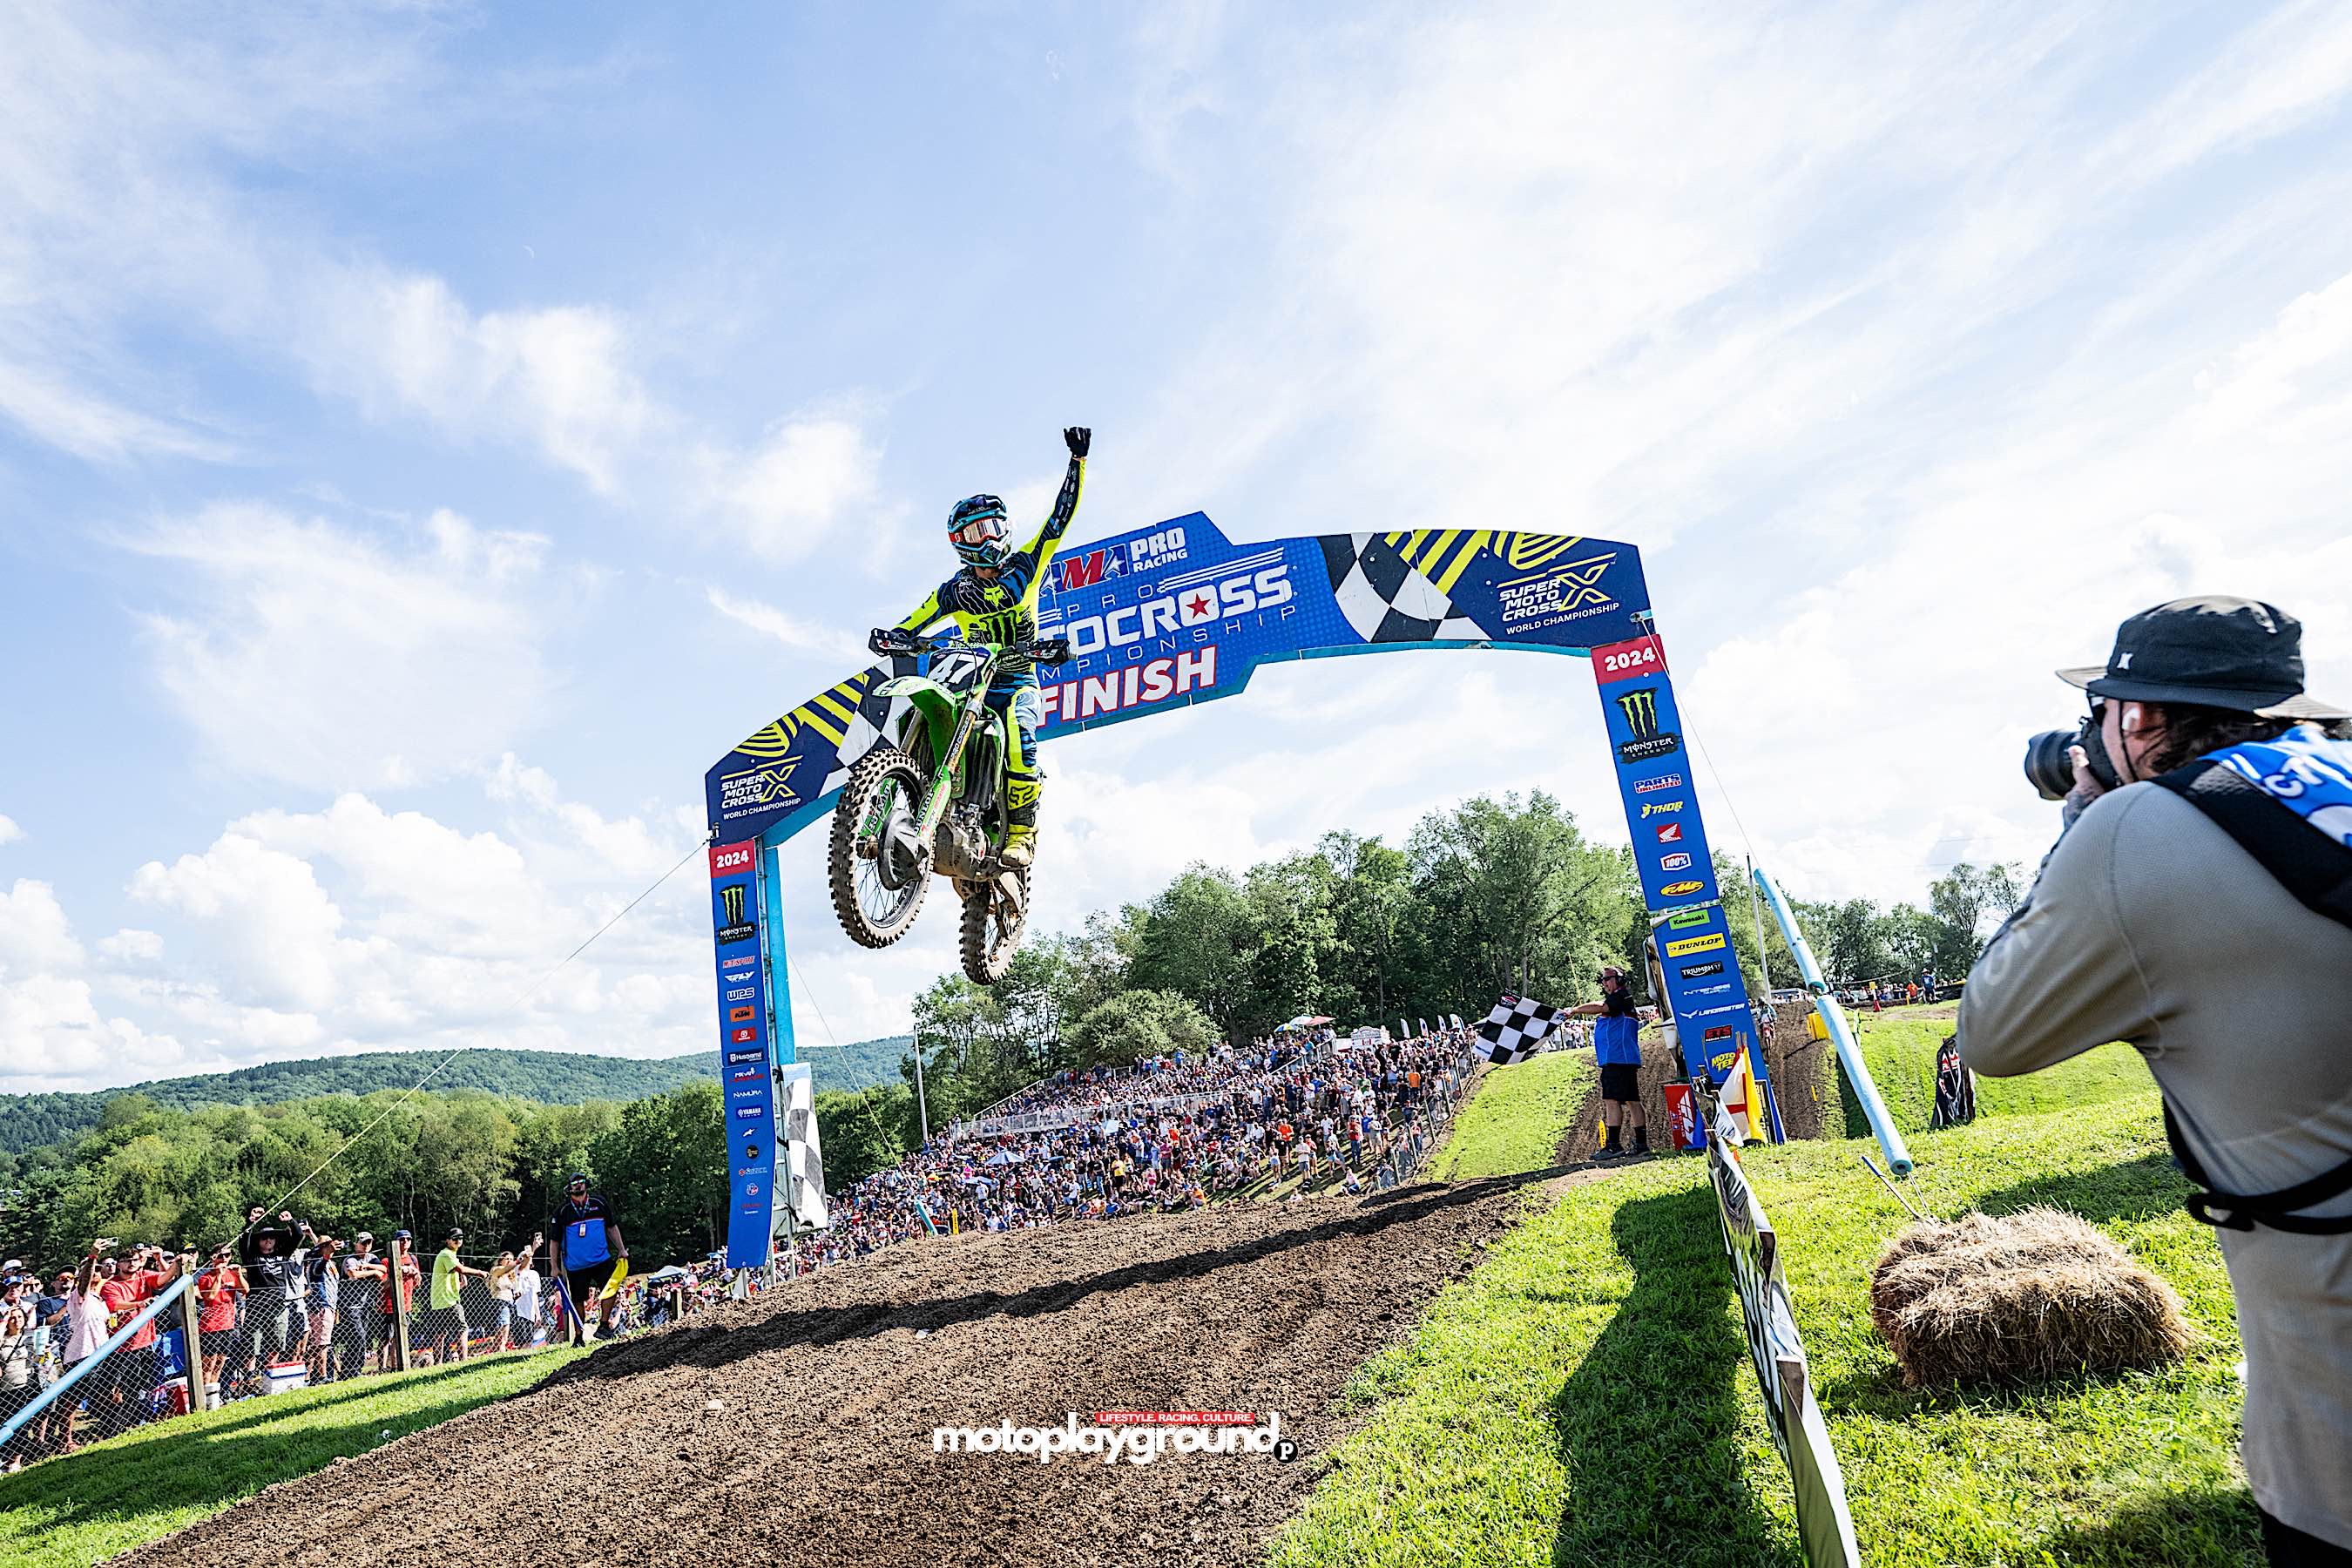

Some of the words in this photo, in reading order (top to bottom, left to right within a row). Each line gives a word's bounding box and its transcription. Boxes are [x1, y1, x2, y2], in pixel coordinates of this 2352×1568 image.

[1130, 527, 1186, 562] PRO
[1133, 549, 1188, 572] RACING
[1038, 544, 1130, 598] AMA
[1499, 578, 1561, 602] SUPER
[1067, 584, 1153, 618] PRO
[1502, 599, 1563, 622] CROSS
[1505, 590, 1560, 612] MOTO
[1506, 620, 1542, 635] WORLD
[1543, 602, 1620, 626] CHAMPIONSHIP
[1041, 605, 1296, 680] MPIONSHIP
[927, 652, 987, 685] 47
[1605, 646, 1656, 672] 2024
[1037, 644, 1218, 727] FINISH
[1624, 737, 1674, 754] MONSTER
[720, 774, 766, 791] SUPER
[1635, 774, 1680, 788] PARTS
[1636, 781, 1681, 793] UNLIMITED
[721, 792, 764, 808] CROSS
[724, 783, 762, 800] MOTO
[723, 809, 747, 821] WORLD
[748, 797, 801, 814] CHAMPIONSHIP
[914, 787, 935, 835] DUNLOP
[1652, 801, 1684, 814] THOR
[716, 849, 749, 868] 2024
[1665, 856, 1687, 868] 100%
[1678, 936, 1722, 951] DUNLOP
[1681, 964, 1713, 976] TRIUMPH
[727, 987, 755, 1001] WPS
[1705, 1025, 1731, 1038] ETS
[1711, 1052, 1736, 1068] MOTO
